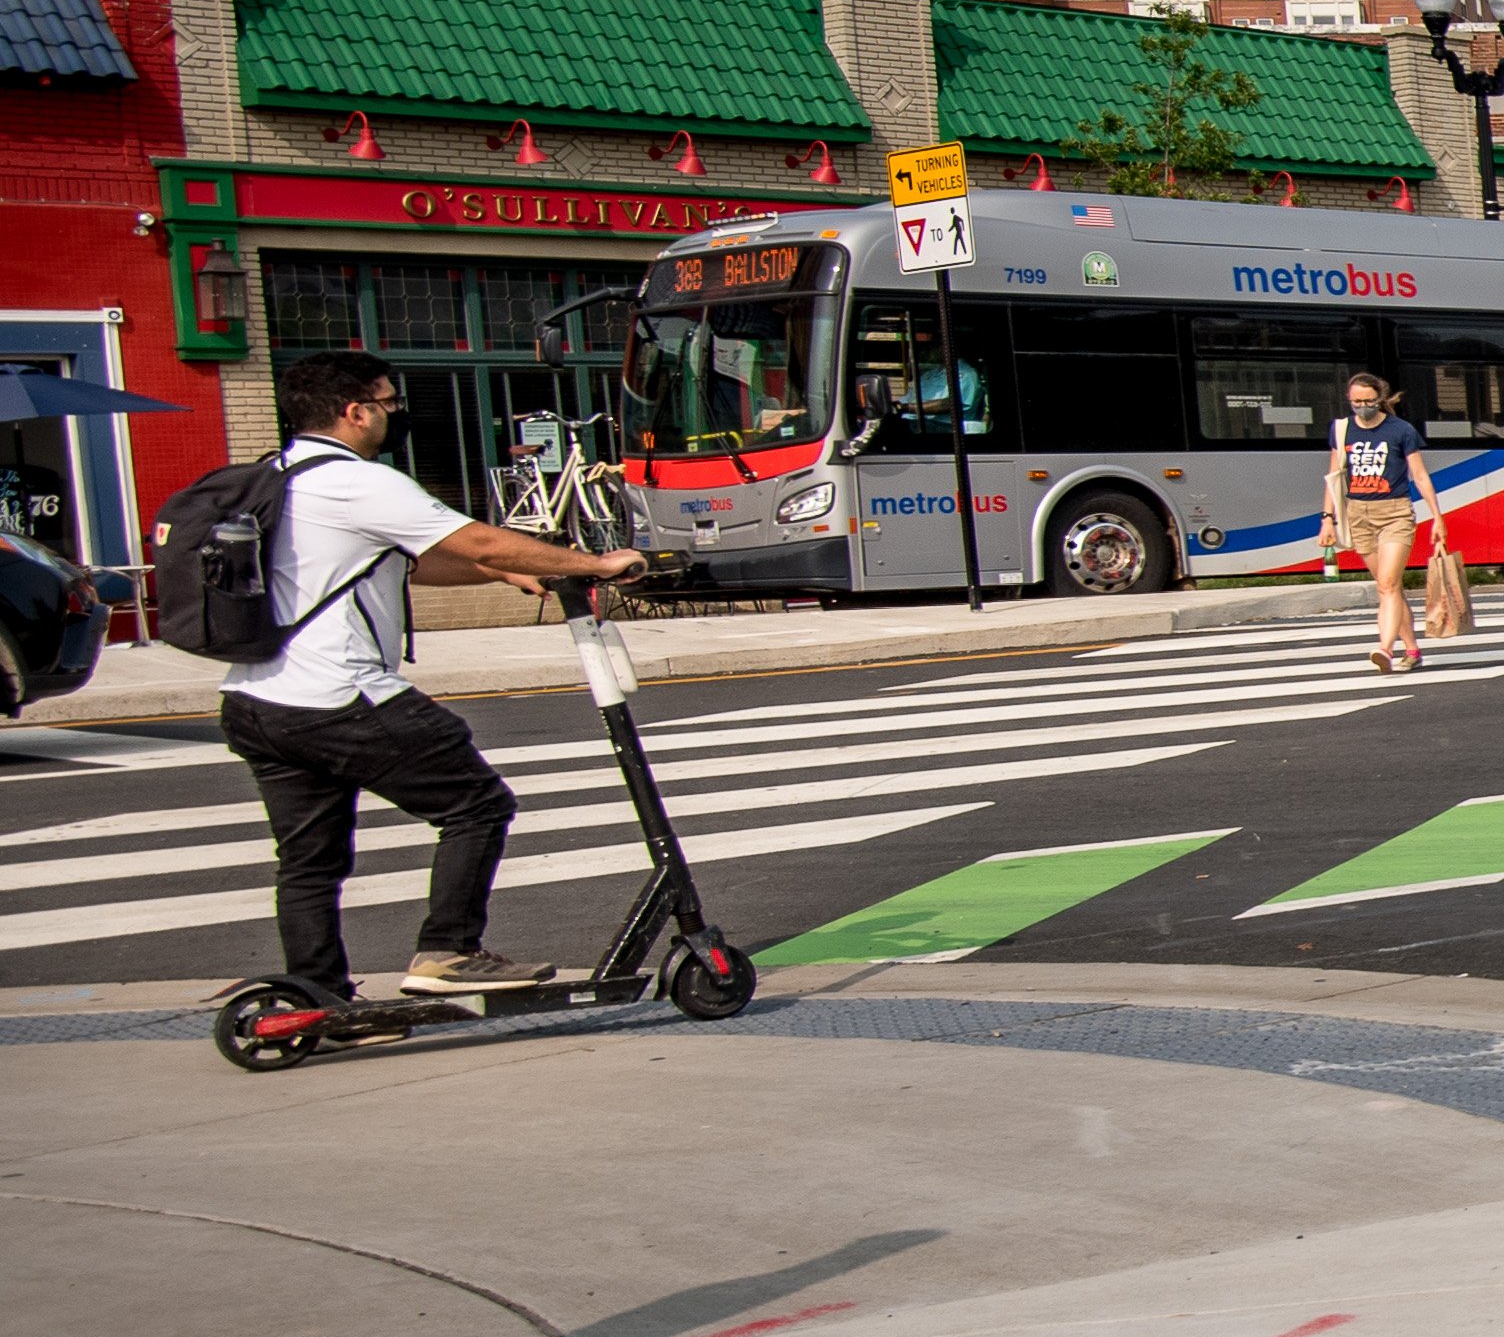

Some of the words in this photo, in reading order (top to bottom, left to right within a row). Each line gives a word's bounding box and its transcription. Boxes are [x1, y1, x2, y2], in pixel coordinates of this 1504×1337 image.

[915, 153, 959, 173] TURNING
[917, 174, 963, 194] VEHICLES
[930, 227, 944, 243] TO
[723, 247, 799, 287] BALLSTON
[1004, 267, 1047, 284] 7199
[1231, 262, 1418, 299] metrobus
[1351, 441, 1389, 455] CLA
[679, 496, 734, 515] metrobus
